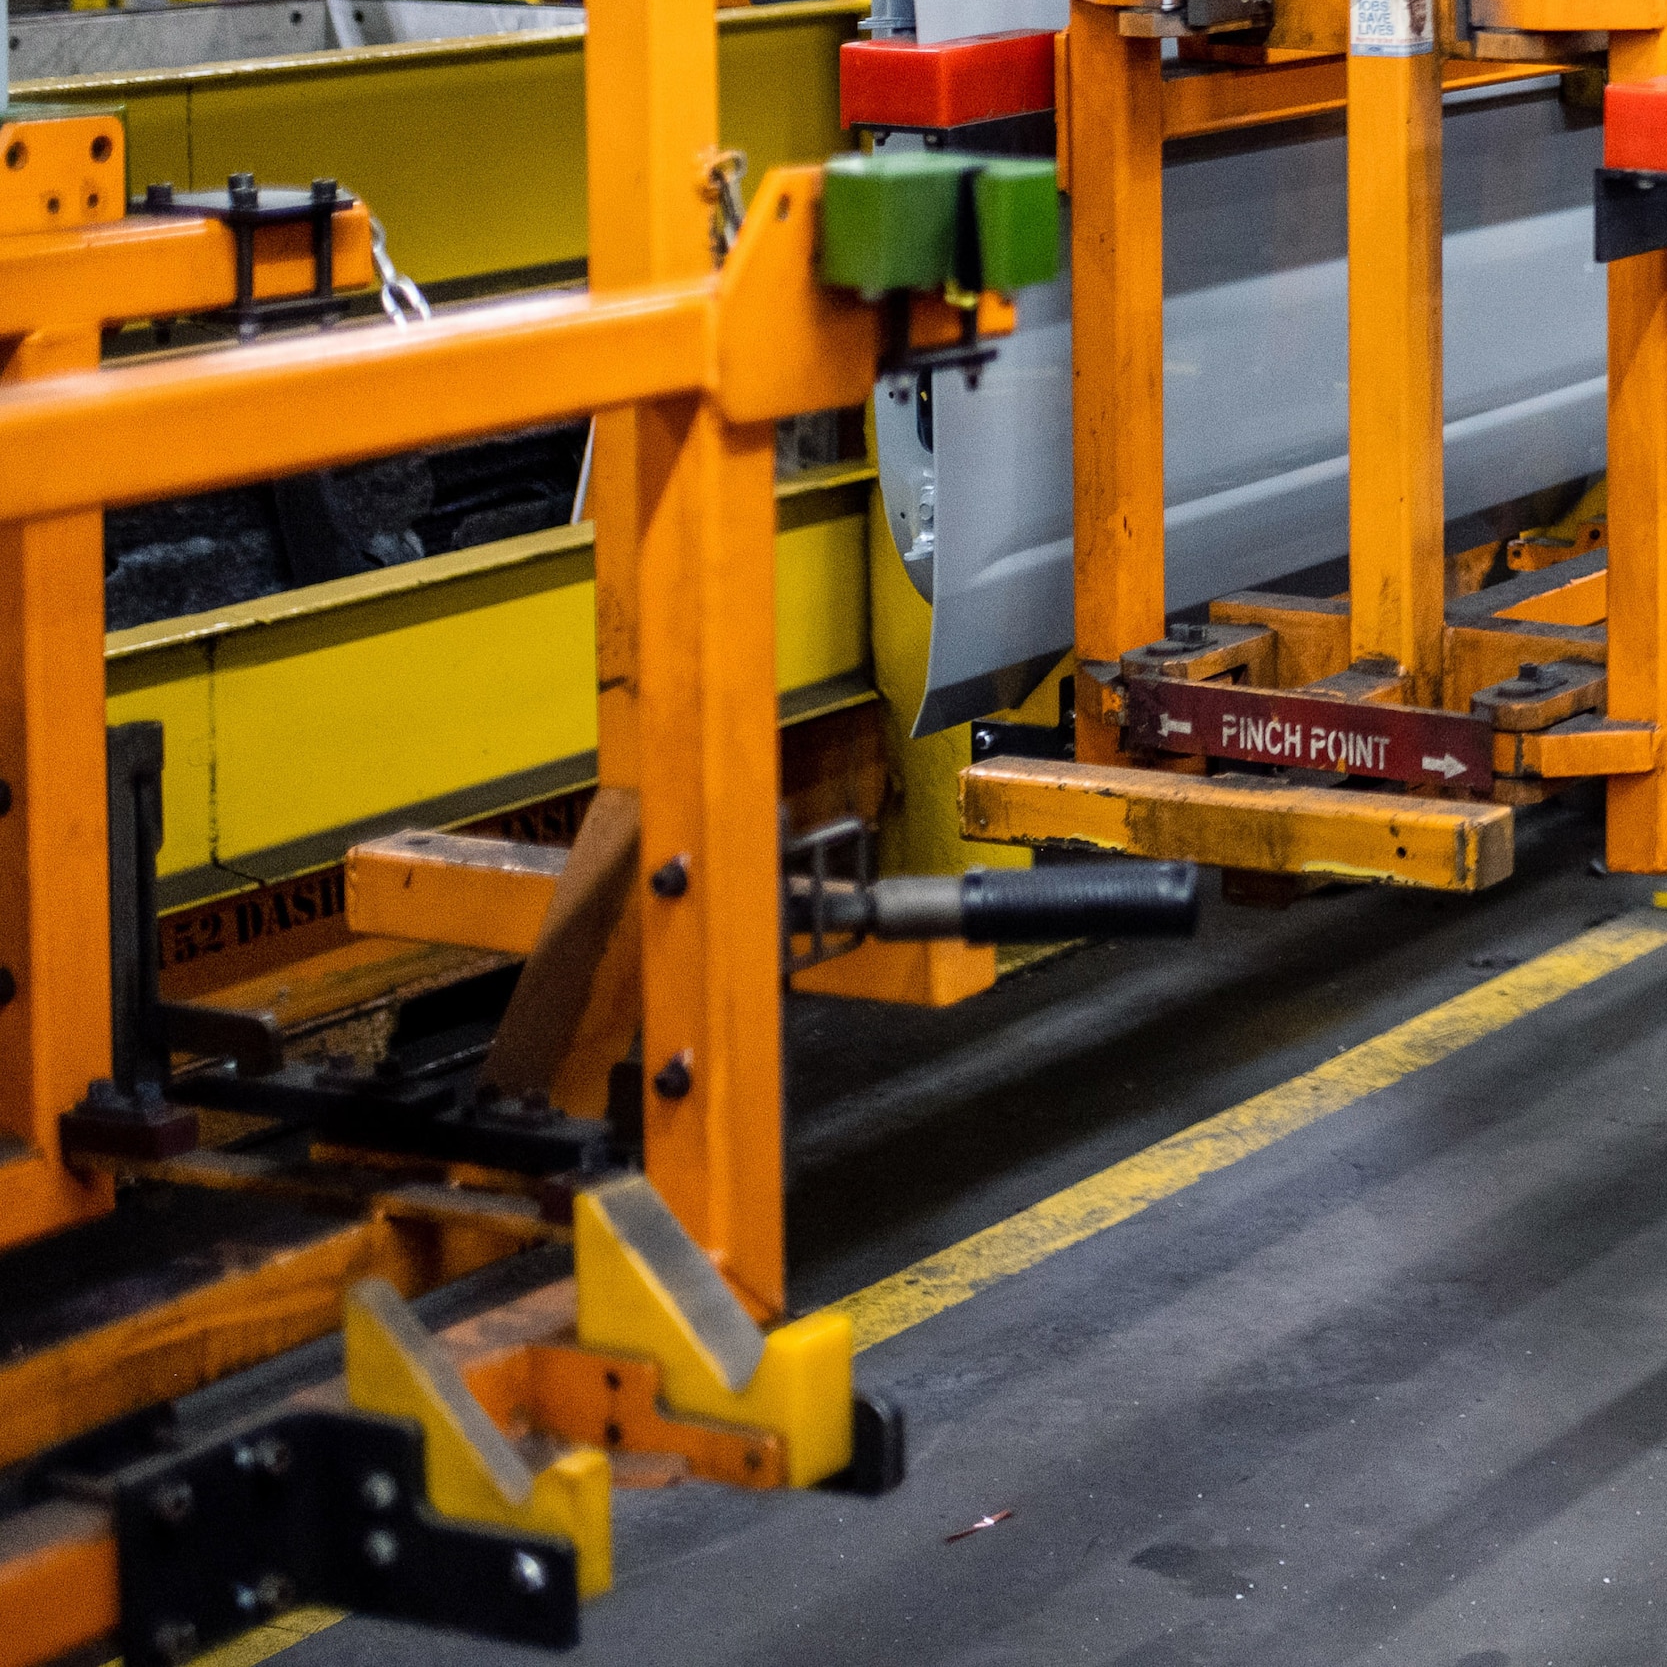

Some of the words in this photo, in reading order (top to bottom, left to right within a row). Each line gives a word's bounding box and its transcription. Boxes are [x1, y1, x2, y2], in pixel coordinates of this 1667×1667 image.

[1358, 1, 1390, 12] JOBS
[1358, 13, 1391, 24] SAVE
[1358, 24, 1395, 36] LIVES
[1222, 713, 1301, 758] PINCH
[1310, 727, 1391, 771] POINT
